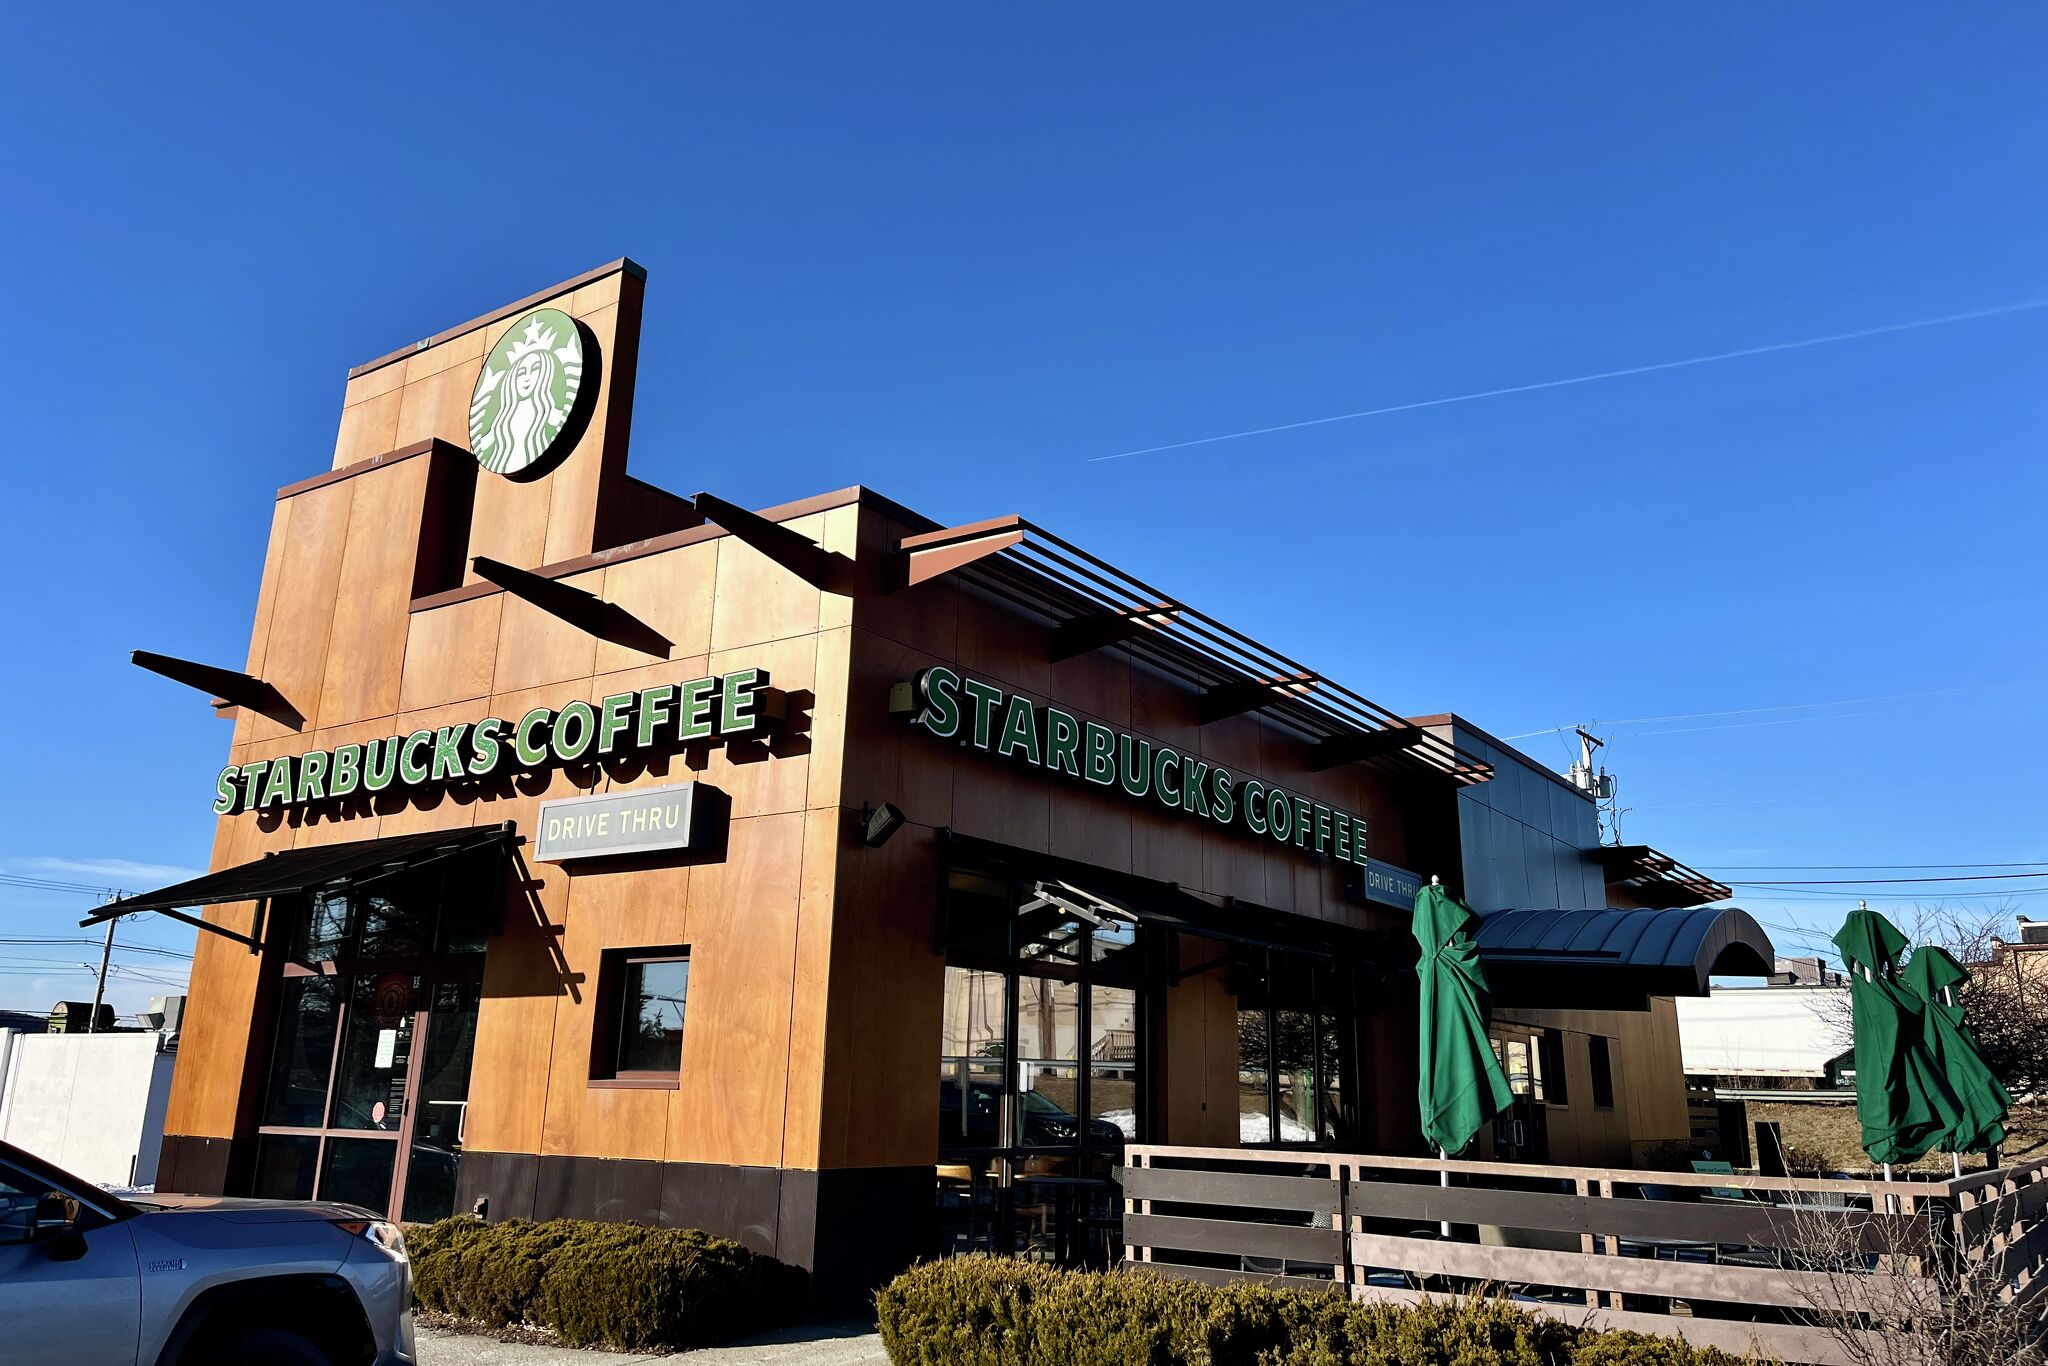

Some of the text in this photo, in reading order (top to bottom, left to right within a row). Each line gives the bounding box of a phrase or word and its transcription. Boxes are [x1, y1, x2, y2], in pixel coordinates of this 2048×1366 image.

[212, 668, 758, 816] STARBUCKS COFFEE
[923, 666, 1368, 866] STARBUCKS COFFEE
[547, 804, 680, 842] DRIVE THRU
[1368, 871, 1394, 893] DRIVE
